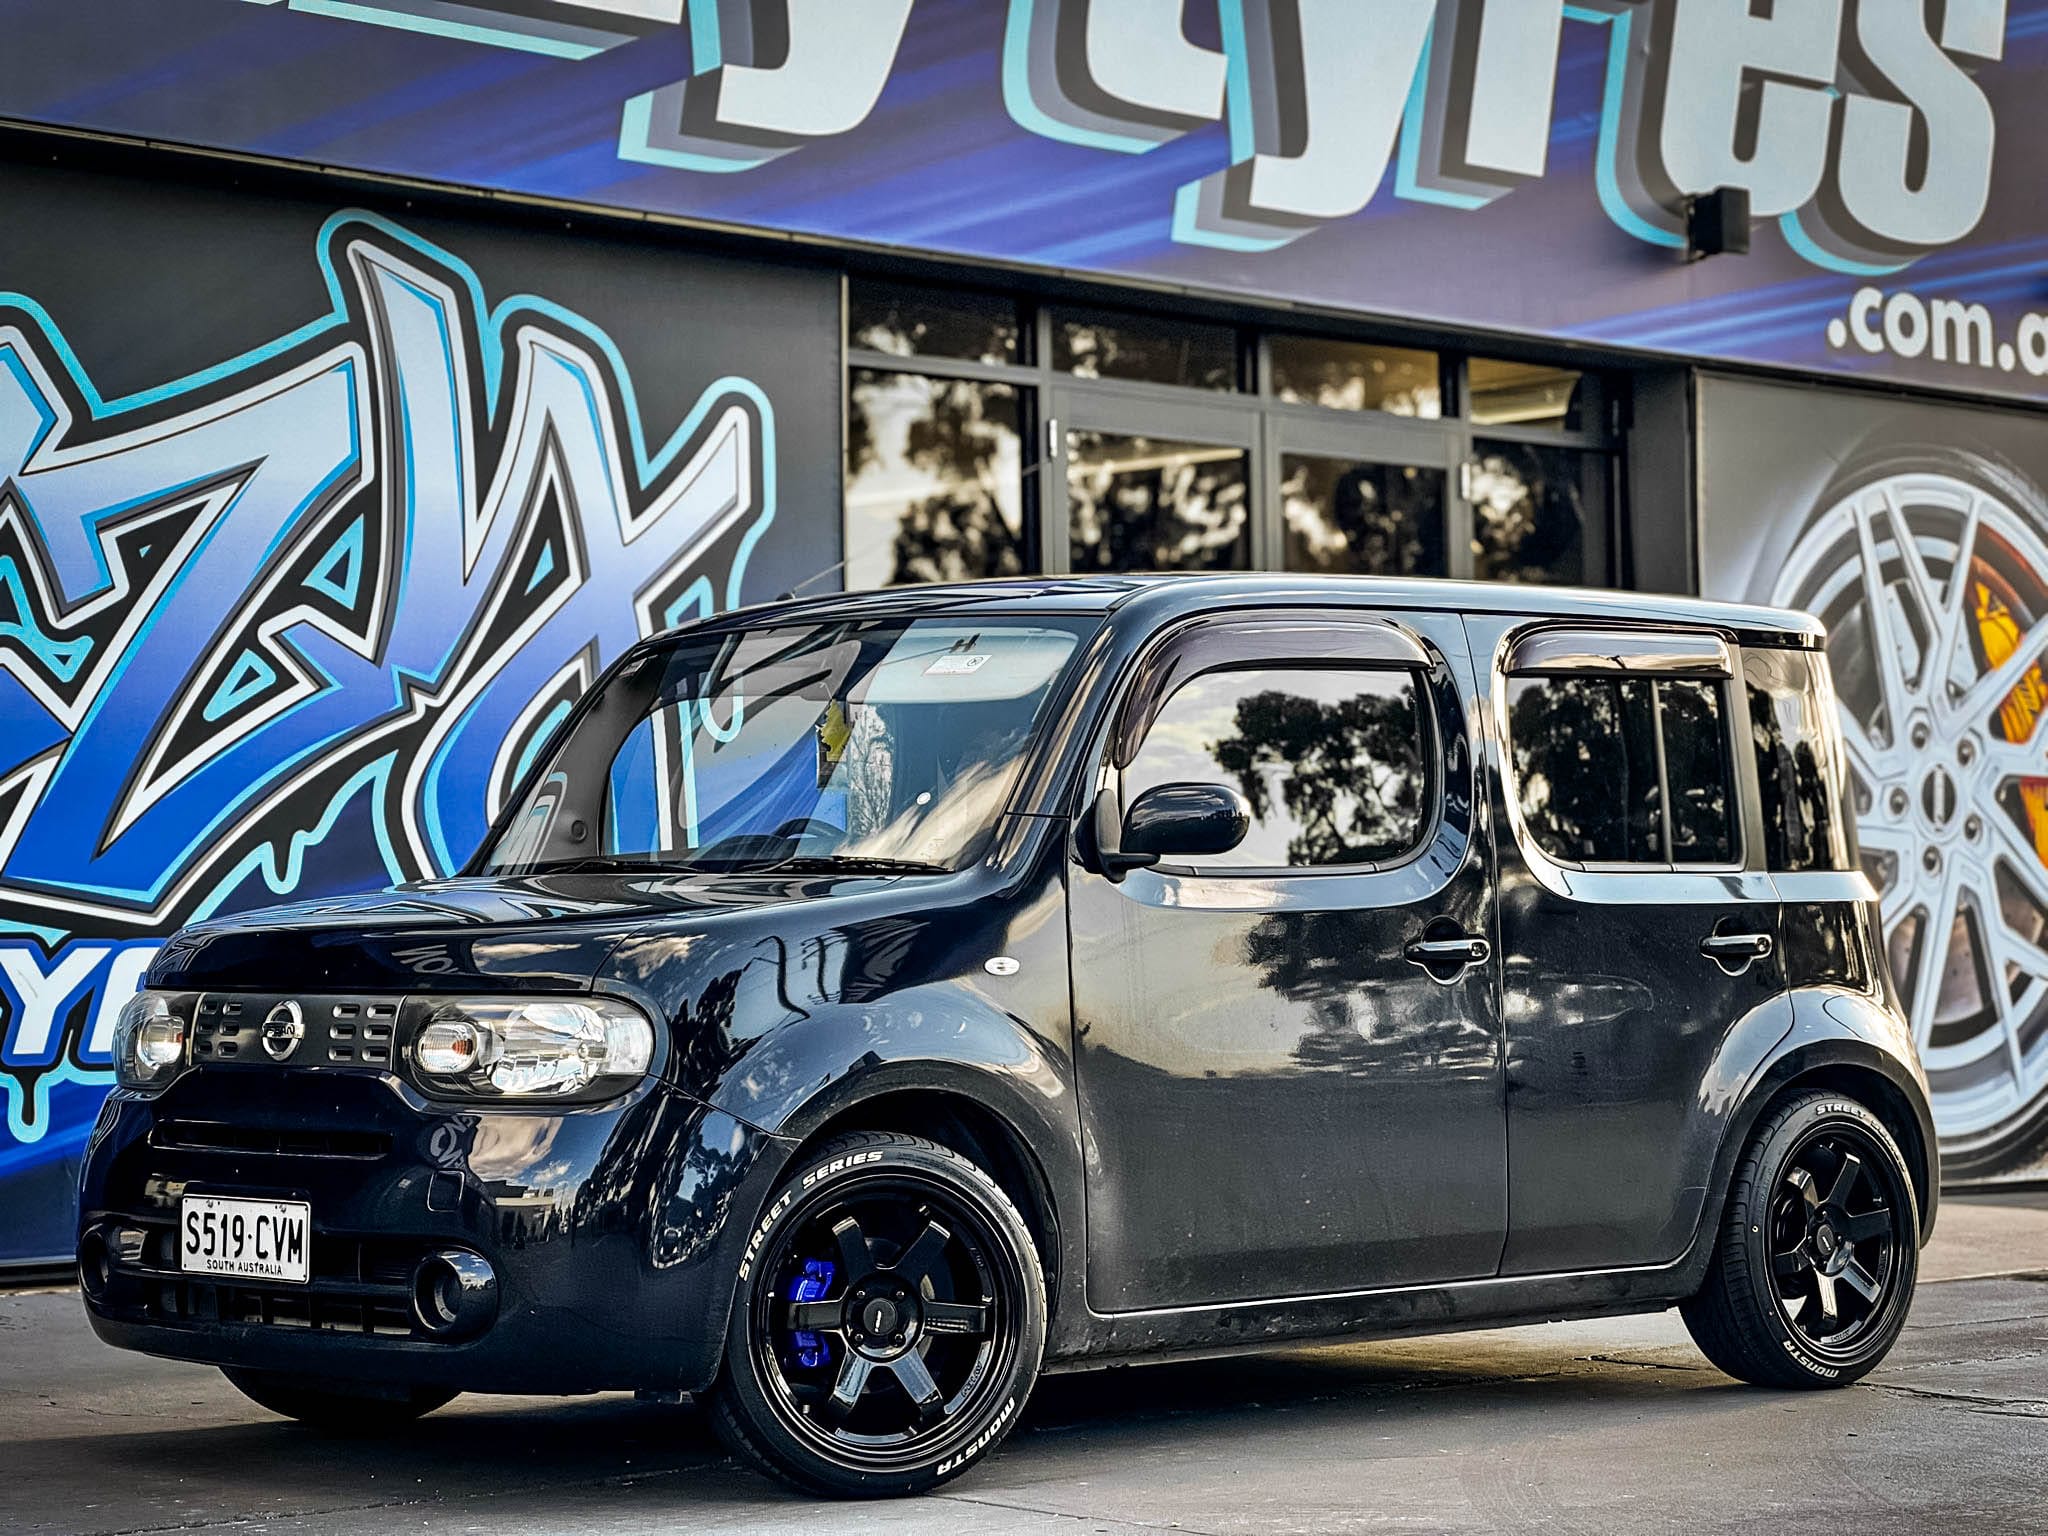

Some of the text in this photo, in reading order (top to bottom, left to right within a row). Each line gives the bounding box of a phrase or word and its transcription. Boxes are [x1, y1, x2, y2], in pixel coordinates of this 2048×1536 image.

[1816, 1103, 1866, 1118] STREET
[738, 1150, 884, 1281] STREET SERIES
[206, 1259, 282, 1275] SOUTH AUSTRALIA
